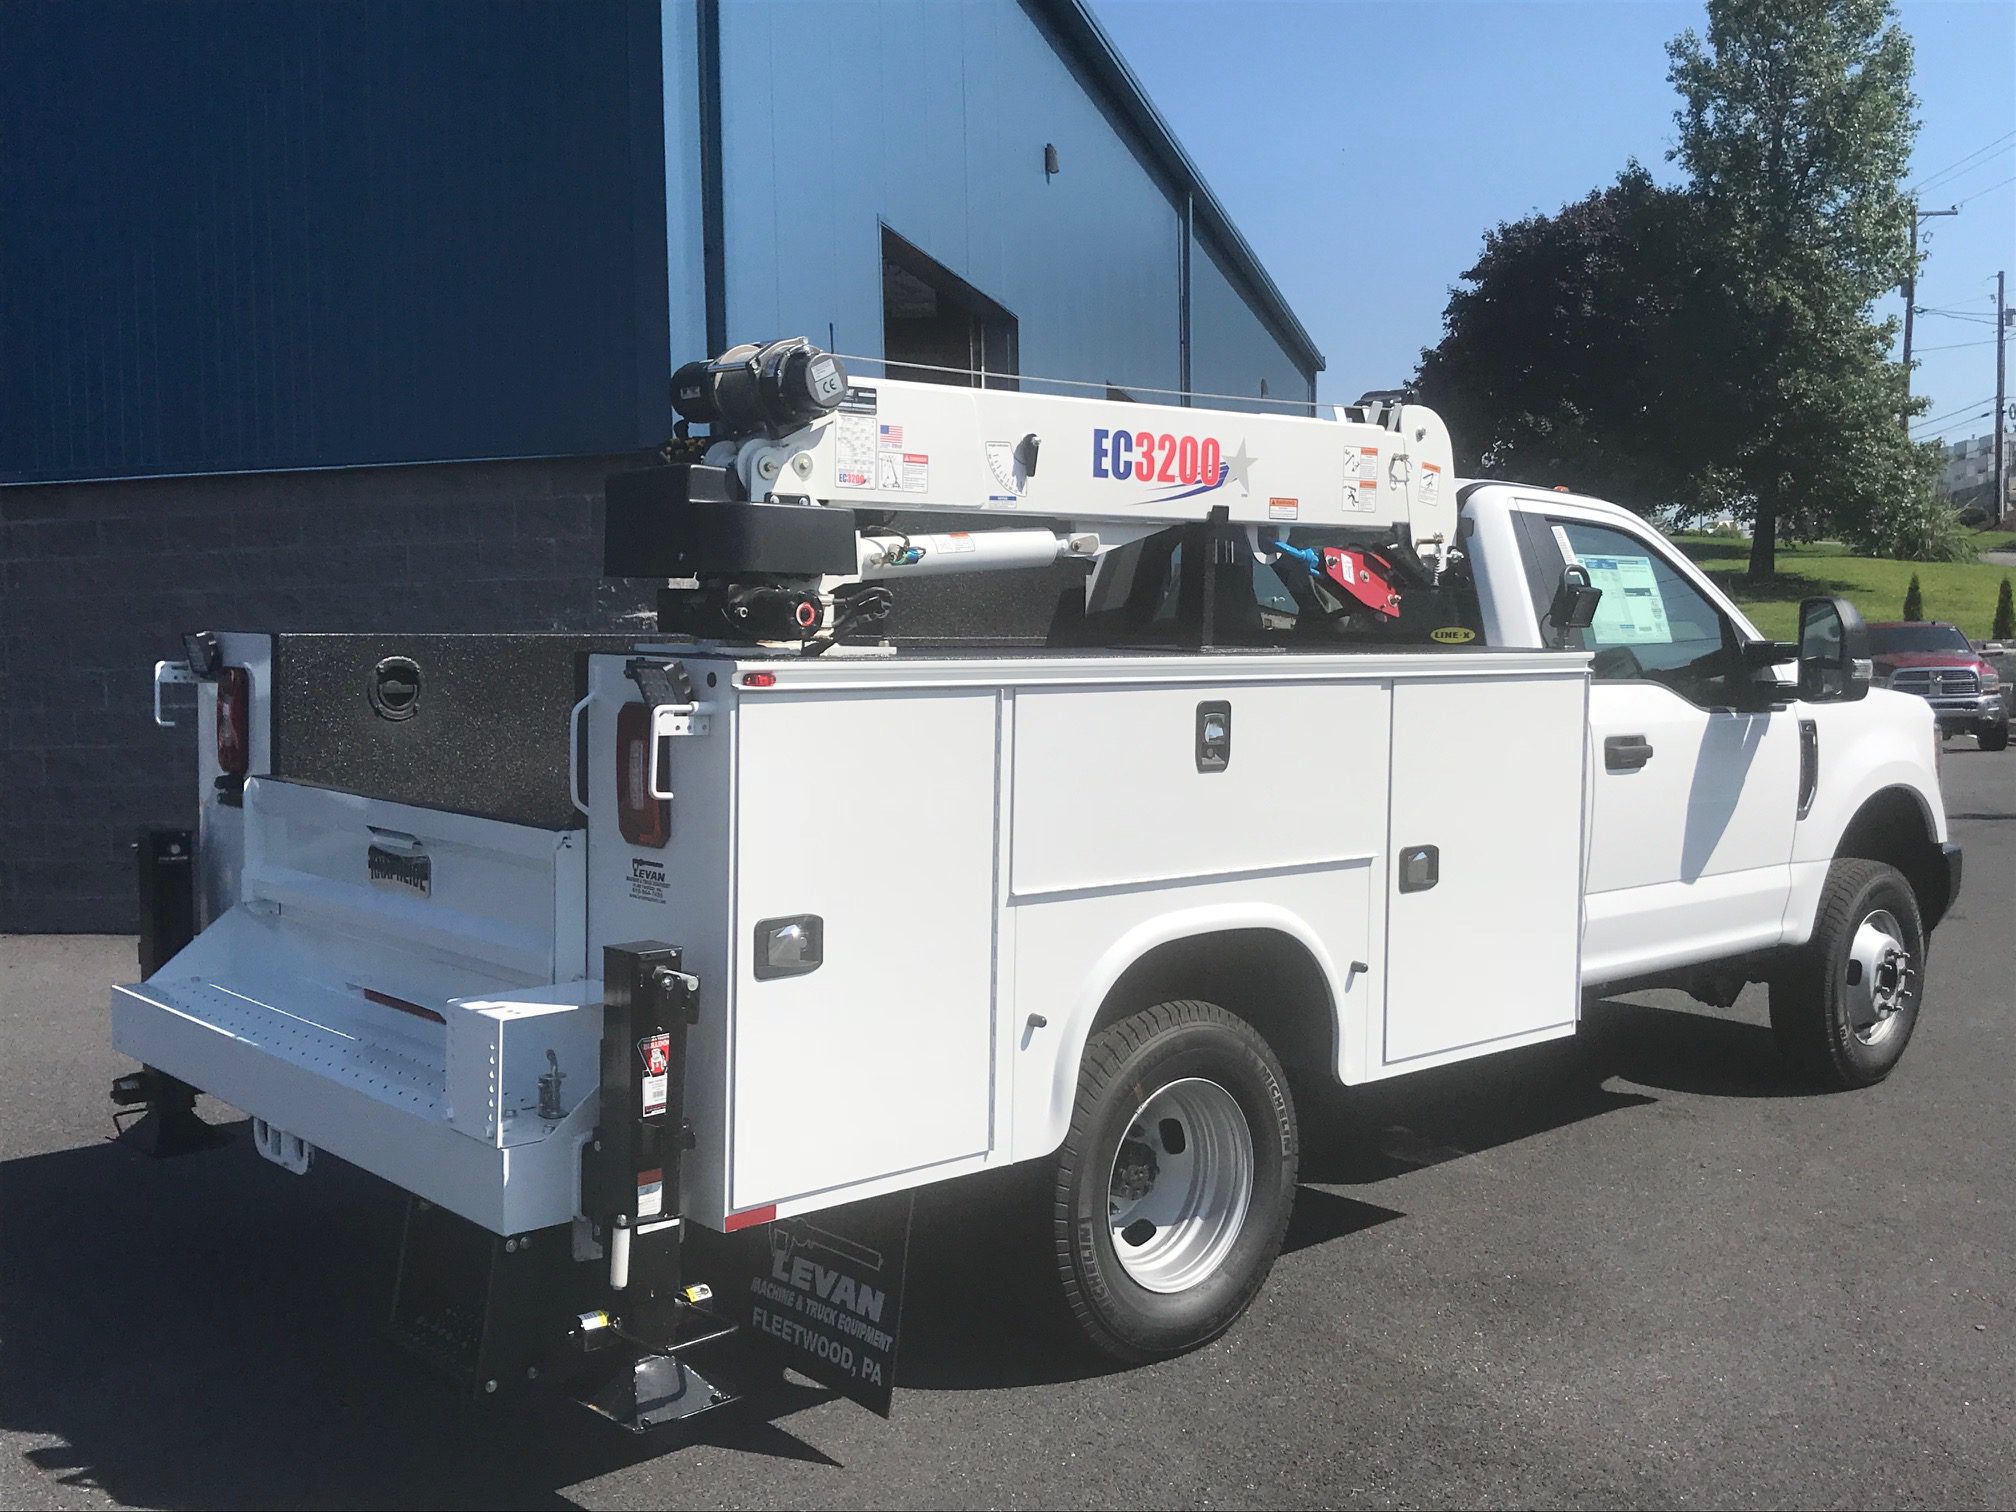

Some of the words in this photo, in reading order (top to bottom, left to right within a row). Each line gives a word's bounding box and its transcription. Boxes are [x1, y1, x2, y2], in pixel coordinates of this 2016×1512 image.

[838, 473, 866, 485] EC3200
[1093, 428, 1220, 487] EC3200
[1434, 630, 1471, 640] LINE-X
[632, 868, 665, 882] LEVAN
[751, 1276, 796, 1308] MACHINE
[795, 1295, 804, 1311] &
[805, 1300, 840, 1327] TRUCK
[837, 1313, 894, 1353] EQUIPMENT
[772, 1250, 886, 1323] LEVAN
[752, 1306, 857, 1377] FLEETWOOD,
[861, 1356, 883, 1387] PA
